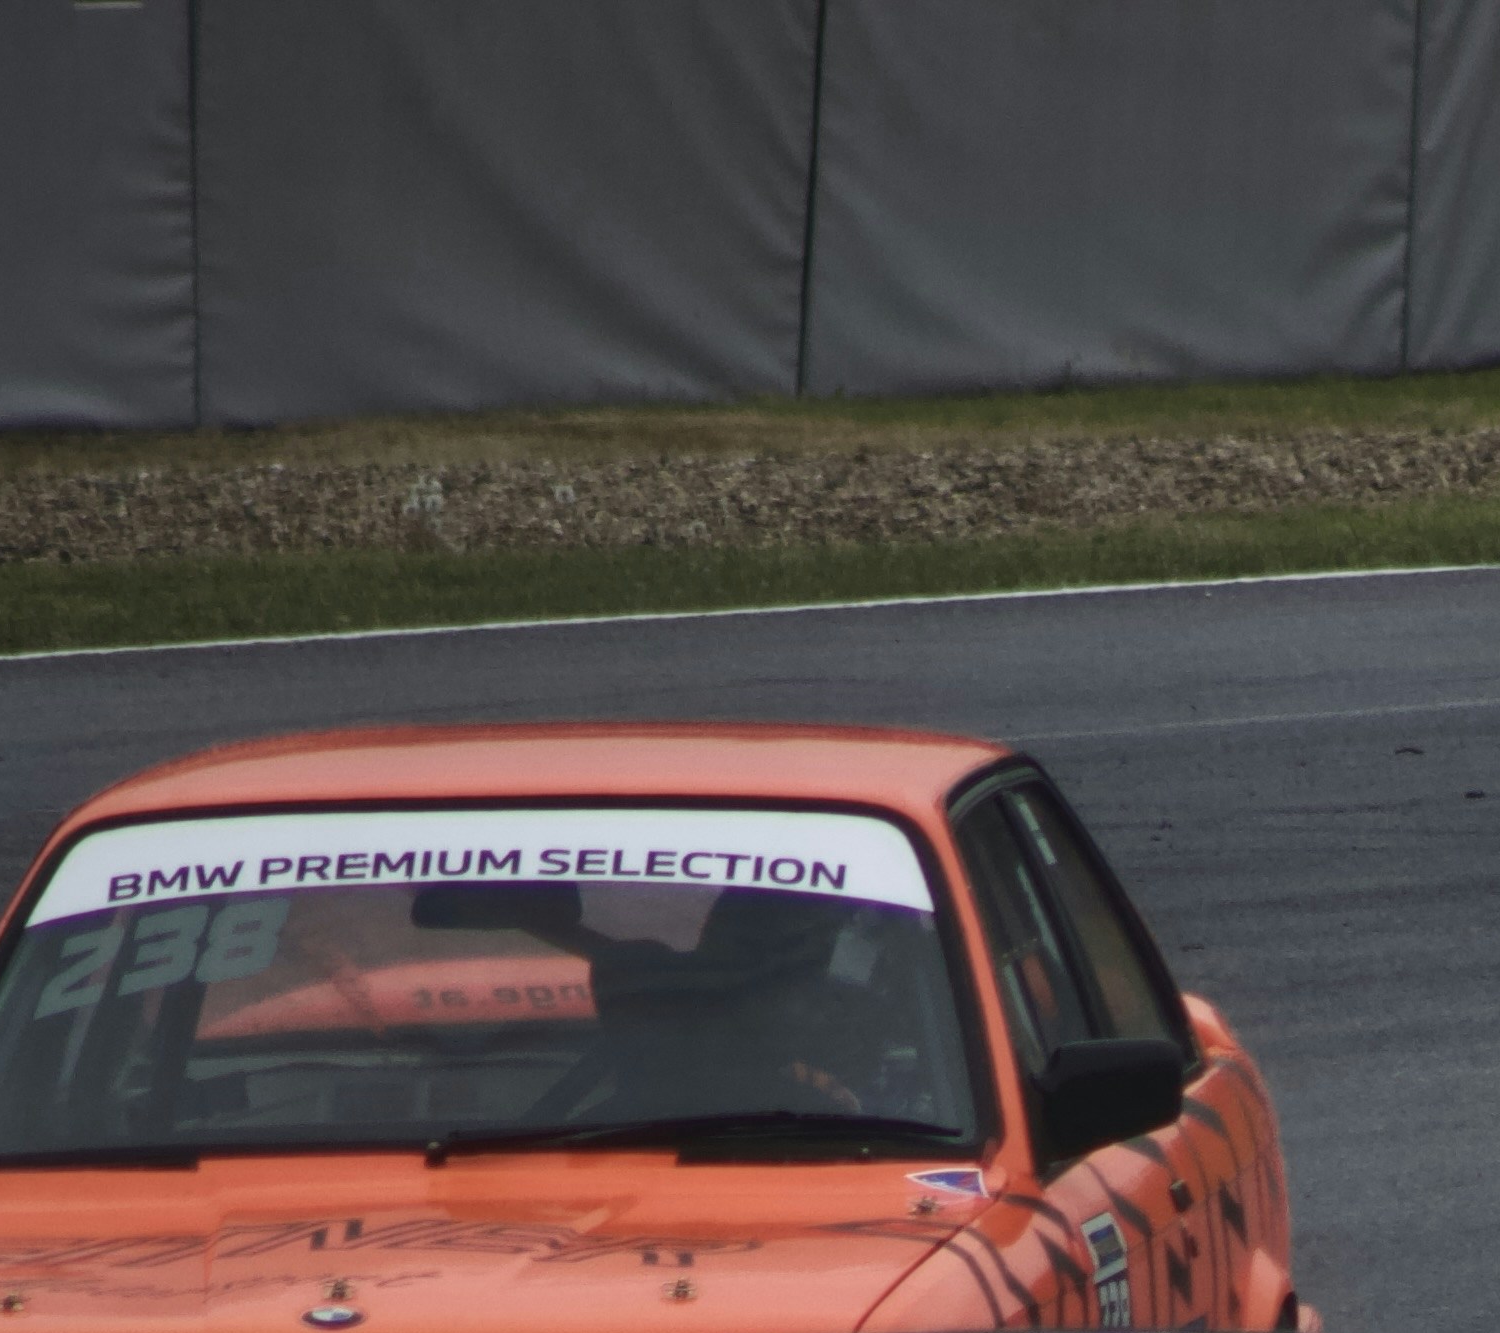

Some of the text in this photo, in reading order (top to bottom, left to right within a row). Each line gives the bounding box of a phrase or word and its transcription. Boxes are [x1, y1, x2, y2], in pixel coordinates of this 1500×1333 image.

[108, 849, 847, 903] BMW PREMIUM SELECTION
[33, 899, 292, 1021] 238
